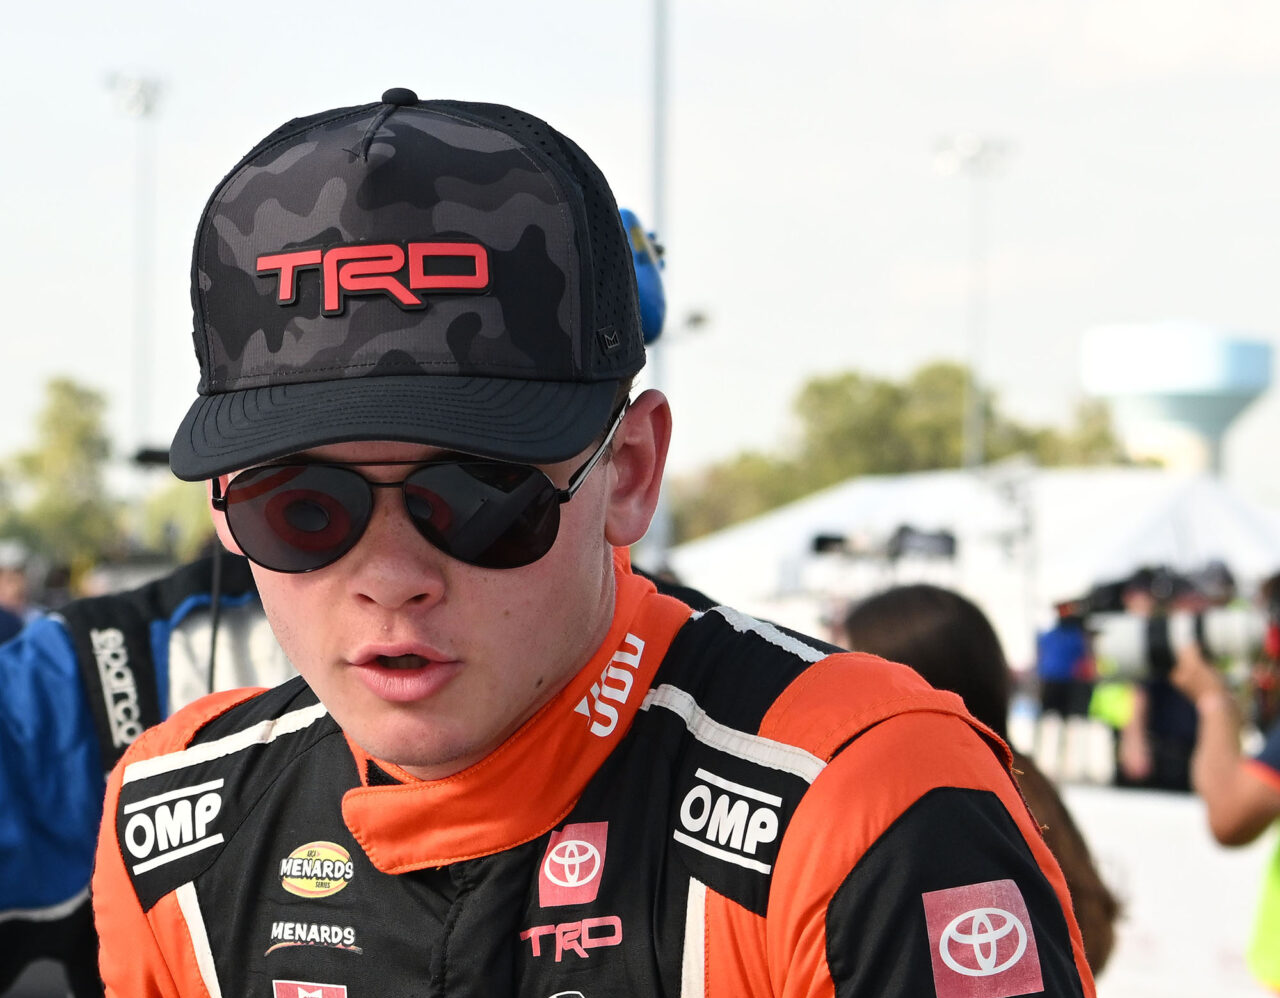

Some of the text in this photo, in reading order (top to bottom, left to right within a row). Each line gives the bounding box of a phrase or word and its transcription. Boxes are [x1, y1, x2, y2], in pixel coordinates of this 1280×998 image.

[256, 242, 489, 311] TRD
[90, 627, 145, 750] sparco
[124, 792, 223, 859] OMP
[680, 784, 780, 855] OMP
[280, 858, 354, 879] MENARDS
[270, 921, 356, 945] MENARDS
[520, 915, 623, 963] TRD
